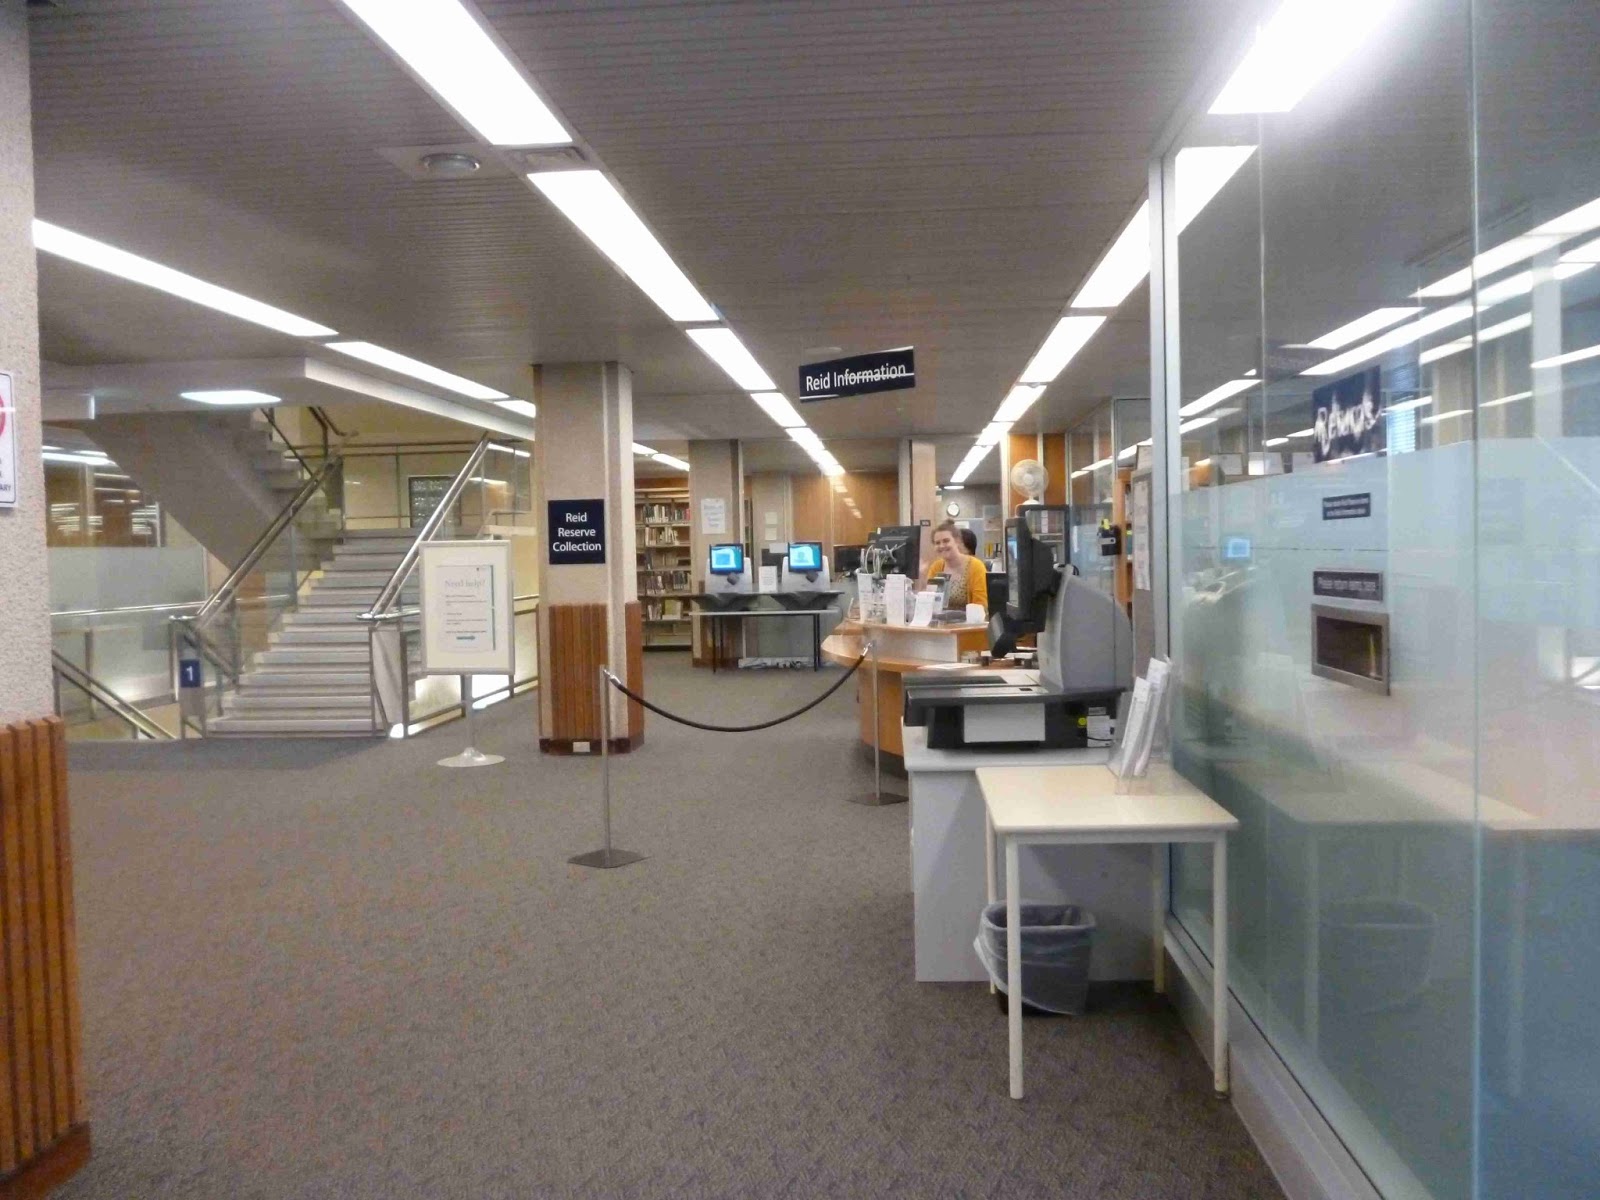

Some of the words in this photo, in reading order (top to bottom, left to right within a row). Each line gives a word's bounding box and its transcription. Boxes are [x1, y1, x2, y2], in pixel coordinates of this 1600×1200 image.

[806, 371, 831, 392] Reid
[833, 362, 907, 388] Information
[565, 511, 588, 523] Reid
[557, 527, 597, 538] Reserve
[552, 541, 602, 552] Collection
[186, 665, 193, 681] 1
